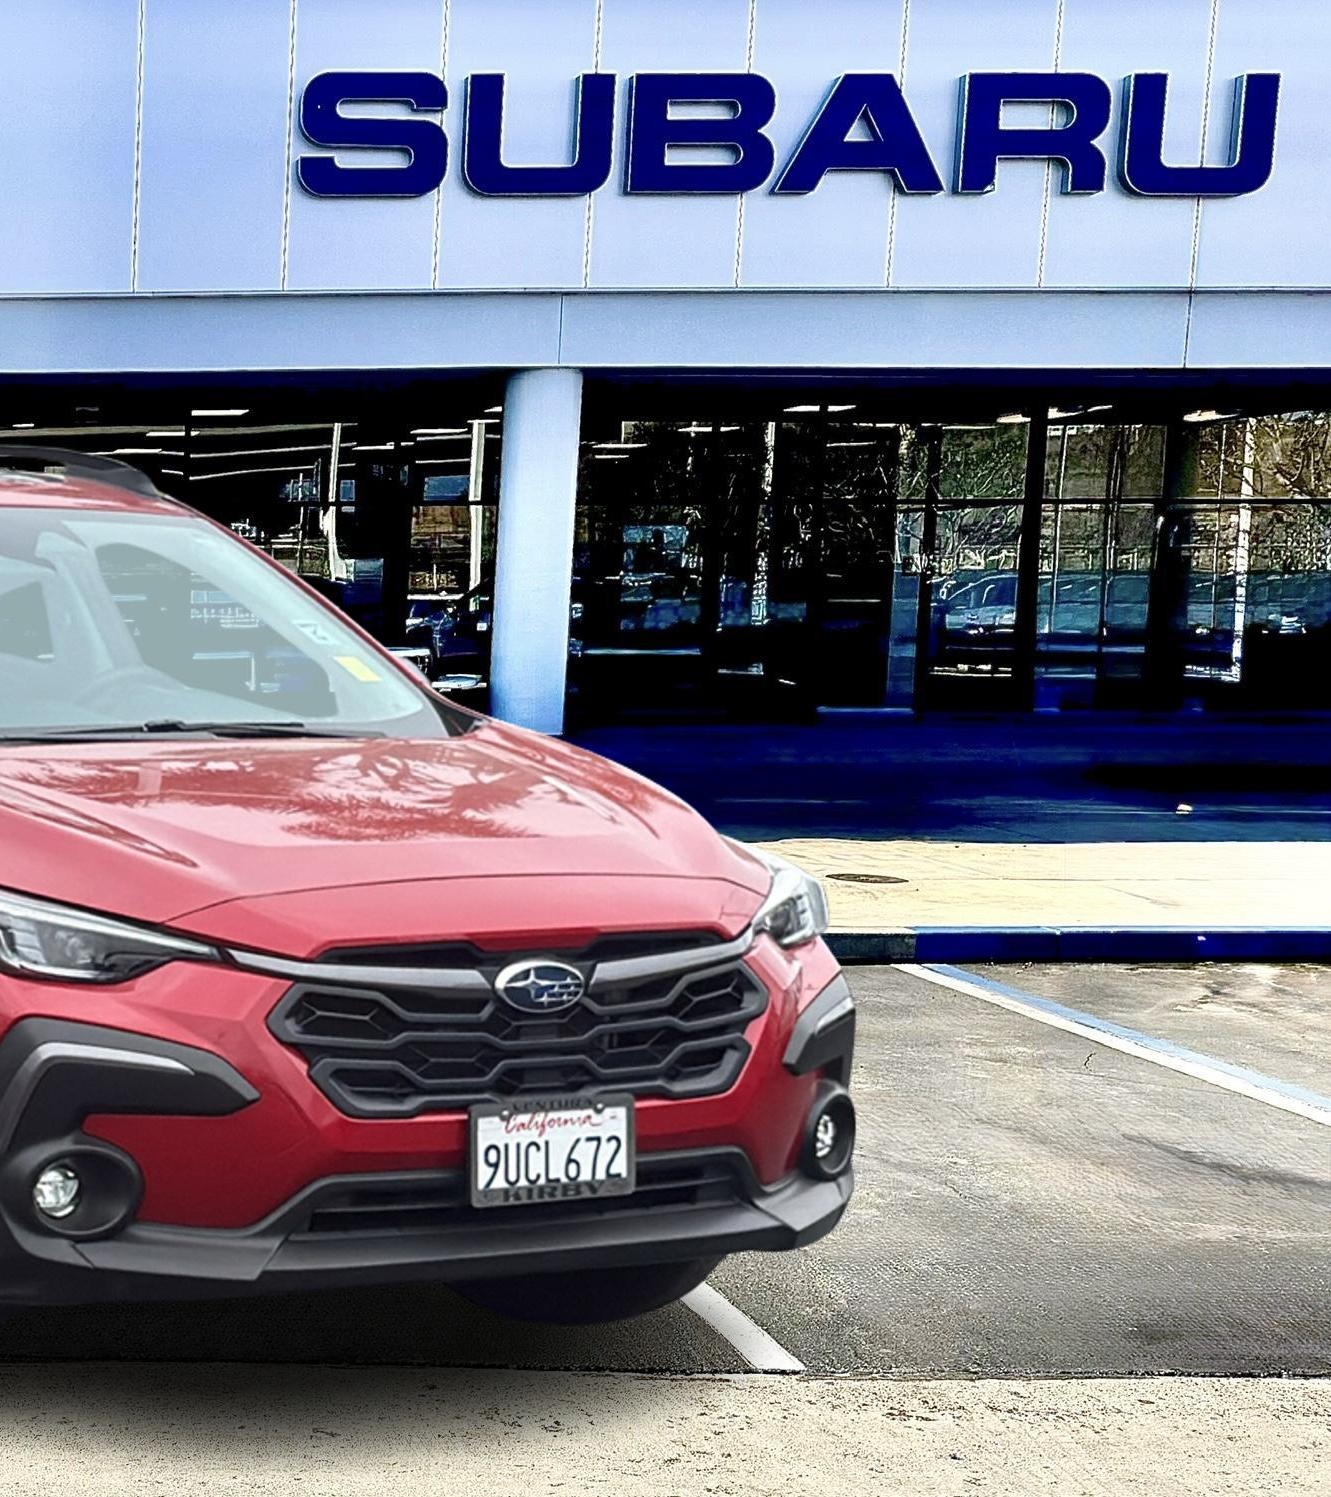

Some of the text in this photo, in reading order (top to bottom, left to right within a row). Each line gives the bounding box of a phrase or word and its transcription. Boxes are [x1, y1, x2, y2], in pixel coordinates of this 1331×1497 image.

[296, 71, 1281, 196] SUBARU
[504, 1111, 603, 1137] California
[483, 1135, 622, 1188] 9UCL672
[502, 1181, 605, 1202] KIRBY
